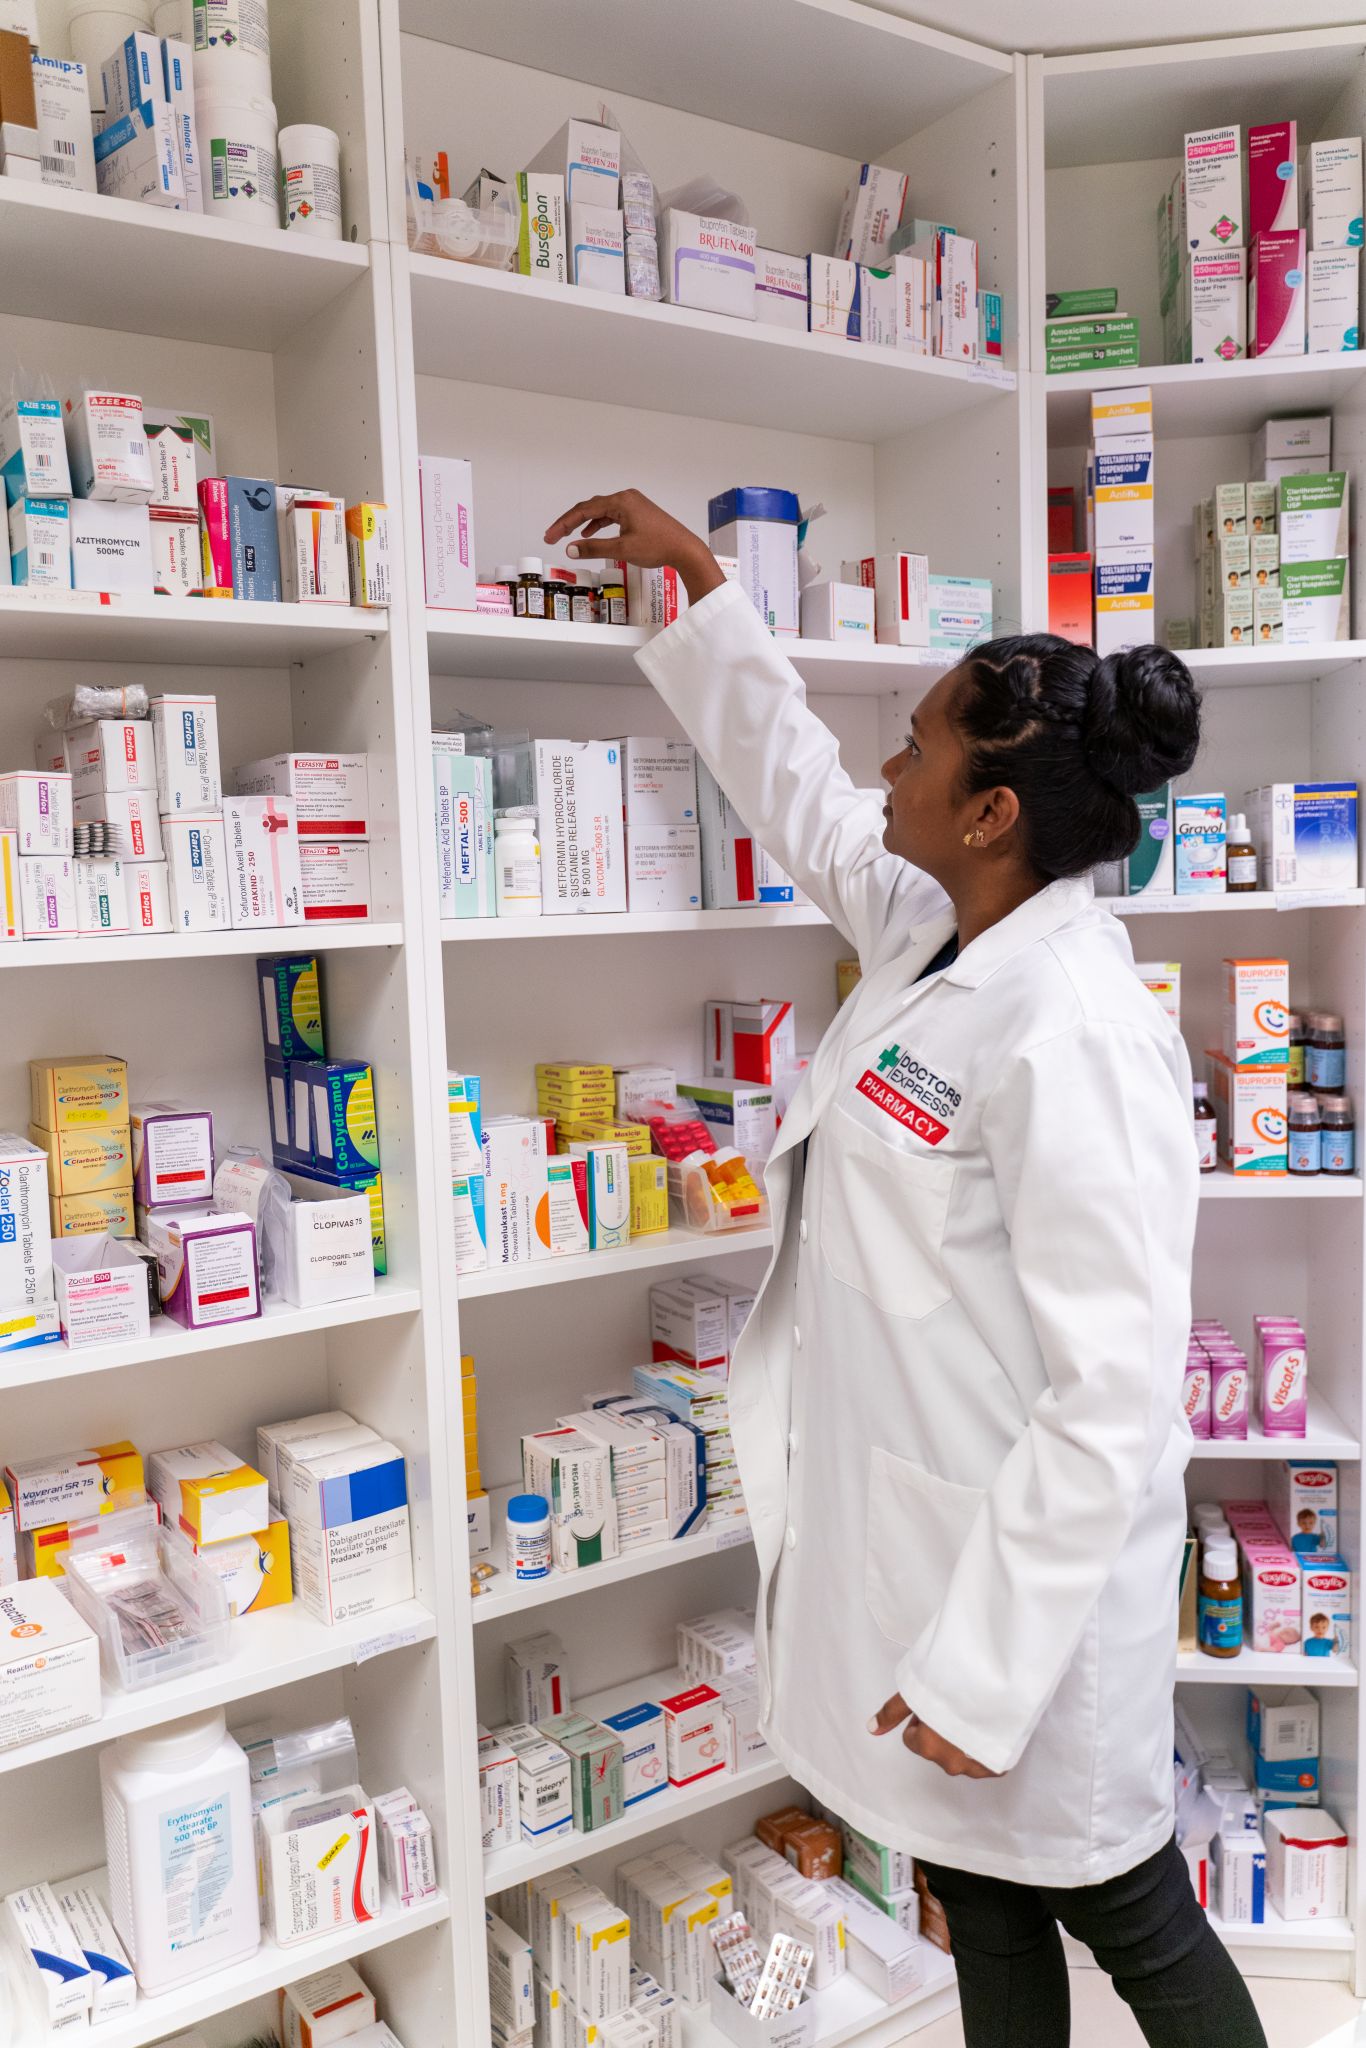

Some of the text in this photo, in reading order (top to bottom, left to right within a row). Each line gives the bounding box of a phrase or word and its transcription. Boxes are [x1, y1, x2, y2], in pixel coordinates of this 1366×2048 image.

[32, 55, 83, 75] Amlip-5
[183, 114, 193, 163] Amlode-10
[1187, 130, 1234, 144] Amoxicillin
[1188, 142, 1234, 156] 250mg/5ml
[581, 154, 618, 170] BRUFEN 200
[1202, 153, 1238, 164] Suspension
[1188, 166, 1206, 174] Sugar
[536, 194, 550, 268] Buscopan
[610, 240, 622, 248] 200
[699, 233, 754, 257] BRUFEN 400
[1194, 253, 1240, 262] Amoxicillin
[1195, 264, 1239, 274] 250mg/5ml
[765, 275, 802, 292] BRUFEN 600
[1208, 275, 1244, 283] Suspension
[1051, 323, 1134, 336] Amoxicillin 3g Sachet
[1050, 348, 1133, 362] Amoxicillin 3g Sachet
[92, 398, 141, 408] AZEE-500
[1099, 454, 1150, 465] OSELTAMIVIR ORAL
[1099, 464, 1132, 474] SUSPENSION
[233, 504, 242, 557] Dihydrochloride
[75, 537, 140, 548] AZITHROMYCIN
[96, 548, 124, 556] 500MG
[247, 548, 254, 569] 16 mg
[437, 547, 446, 593] Levodopa
[1100, 564, 1151, 575] OSELTAMIVIR ORAL
[1100, 575, 1133, 585] SUSPENSION
[183, 712, 194, 748] Carloc
[125, 727, 136, 761] Carloc
[187, 751, 195, 762] 25
[128, 762, 137, 781] 12.5
[39, 782, 48, 814] Carloc
[130, 801, 139, 818] 12.5
[232, 811, 240, 819] IP
[552, 755, 567, 898] METFORMIN HYDROCHLORIDE
[565, 756, 579, 897] SUSTAINED RELEASE TABLETS
[1179, 823, 1223, 834] Gravol
[131, 821, 144, 854] Carloc
[440, 785, 452, 890] Mefenamic Acid Tablets BP
[189, 830, 200, 866] Carloc
[140, 873, 150, 890] 12.5
[194, 868, 202, 880] 25
[581, 850, 591, 897] IP 500 MG
[239, 873, 248, 918] Cefuroxime
[250, 875, 260, 917] CEFAKIND
[47, 896, 59, 928] Carloc
[99, 895, 111, 926] Carloc
[140, 893, 153, 926] Carloc
[1239, 969, 1286, 978] IBUPROFEN
[278, 966, 294, 1058] Co-Dydramol
[900, 1055, 961, 1107] DOCTORS
[1237, 1076, 1285, 1085] IBUPROFEN
[58, 1085, 95, 1094] Clarithromycin
[67, 1093, 113, 1102] Clarbact-500
[890, 1069, 950, 1117] EXPRESS
[862, 1077, 938, 1136] PHARMACY
[330, 1075, 349, 1171] Co-Dydramol
[614, 1129, 641, 1138] Moxicip
[71, 1155, 117, 1164] Clarbact-500
[500, 1183, 508, 1196] mg
[0, 1168, 14, 1241] Zoclar 250
[19, 1166, 35, 1293] Clarithromycin Tablets IP 250
[73, 1218, 119, 1228] Clarbact-500
[314, 1220, 354, 1229] CLOPIVAS
[310, 1254, 351, 1262] CLOPIDOGREL
[68, 1277, 92, 1285] Zoclar
[20, 1478, 94, 1499] Voveran SR 75
[329, 1518, 406, 1547] Dabigatran Etexilate
[329, 1530, 340, 1538] Rx
[330, 1529, 399, 1556] Mesilate Capsules
[365, 1543, 388, 1555] 75 mg
[7, 1663, 33, 1675] Reactin
[536, 1779, 565, 1795] Eldepryl
[548, 1792, 559, 1800] mg
[167, 1801, 223, 1828] Erythromycin
[178, 1815, 213, 1833] stearate
[174, 1821, 218, 1844] 500 mg BP
